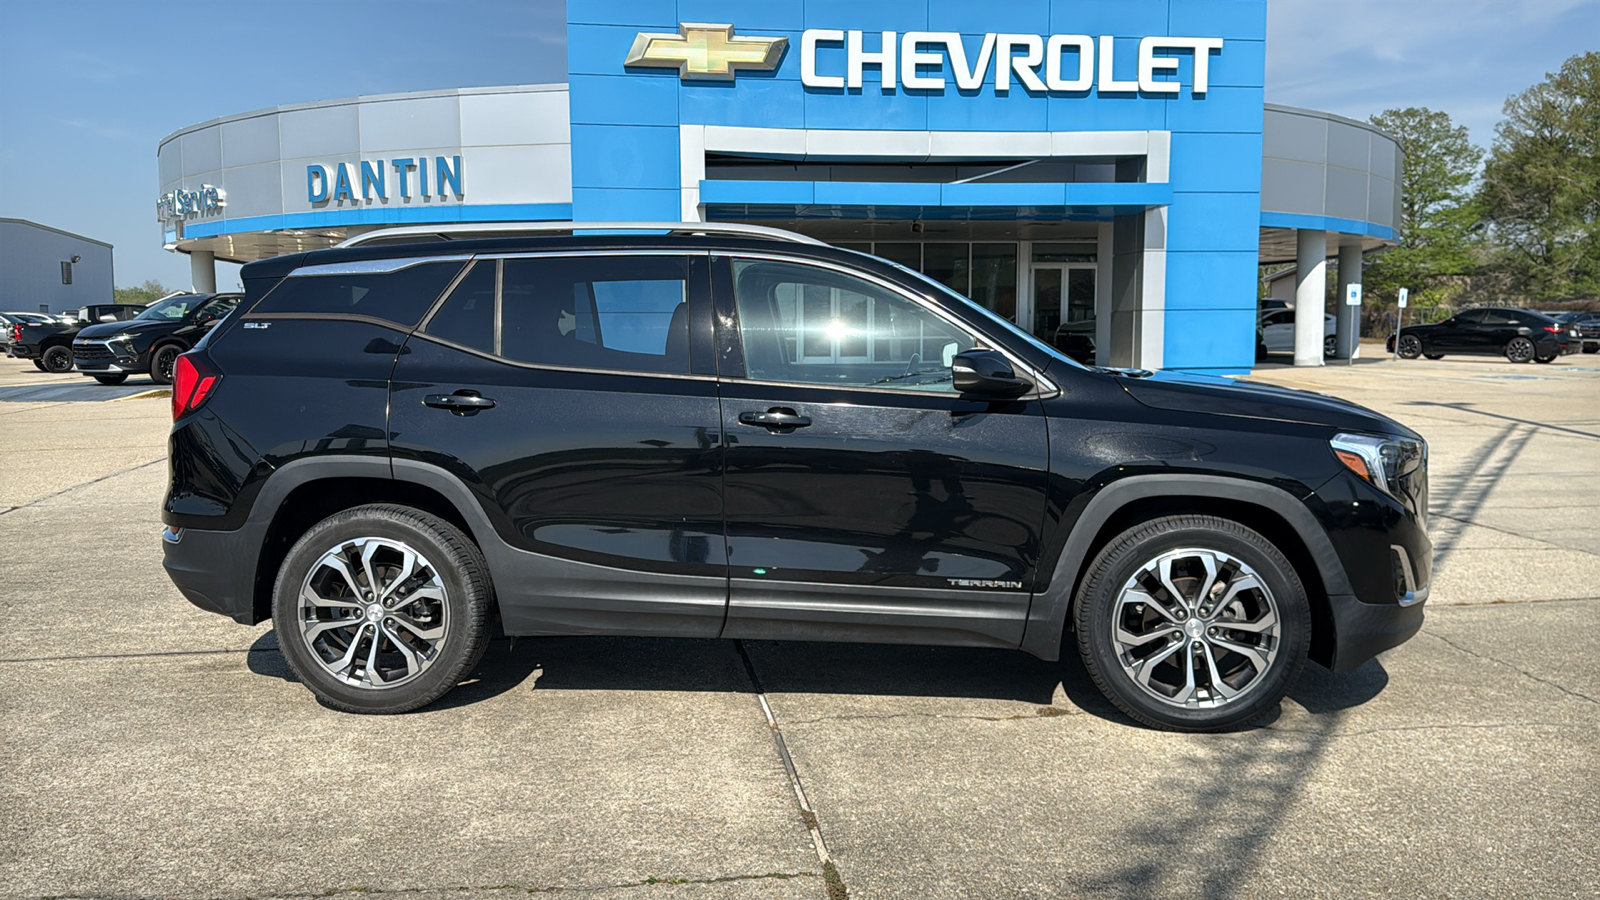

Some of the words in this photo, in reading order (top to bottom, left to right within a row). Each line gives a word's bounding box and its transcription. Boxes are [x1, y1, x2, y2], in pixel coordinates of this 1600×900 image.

[800, 28, 1223, 95] CHEVROLET
[307, 155, 462, 203] DANTIN
[177, 184, 221, 214] Service
[947, 578, 1022, 589] TERRAIN
